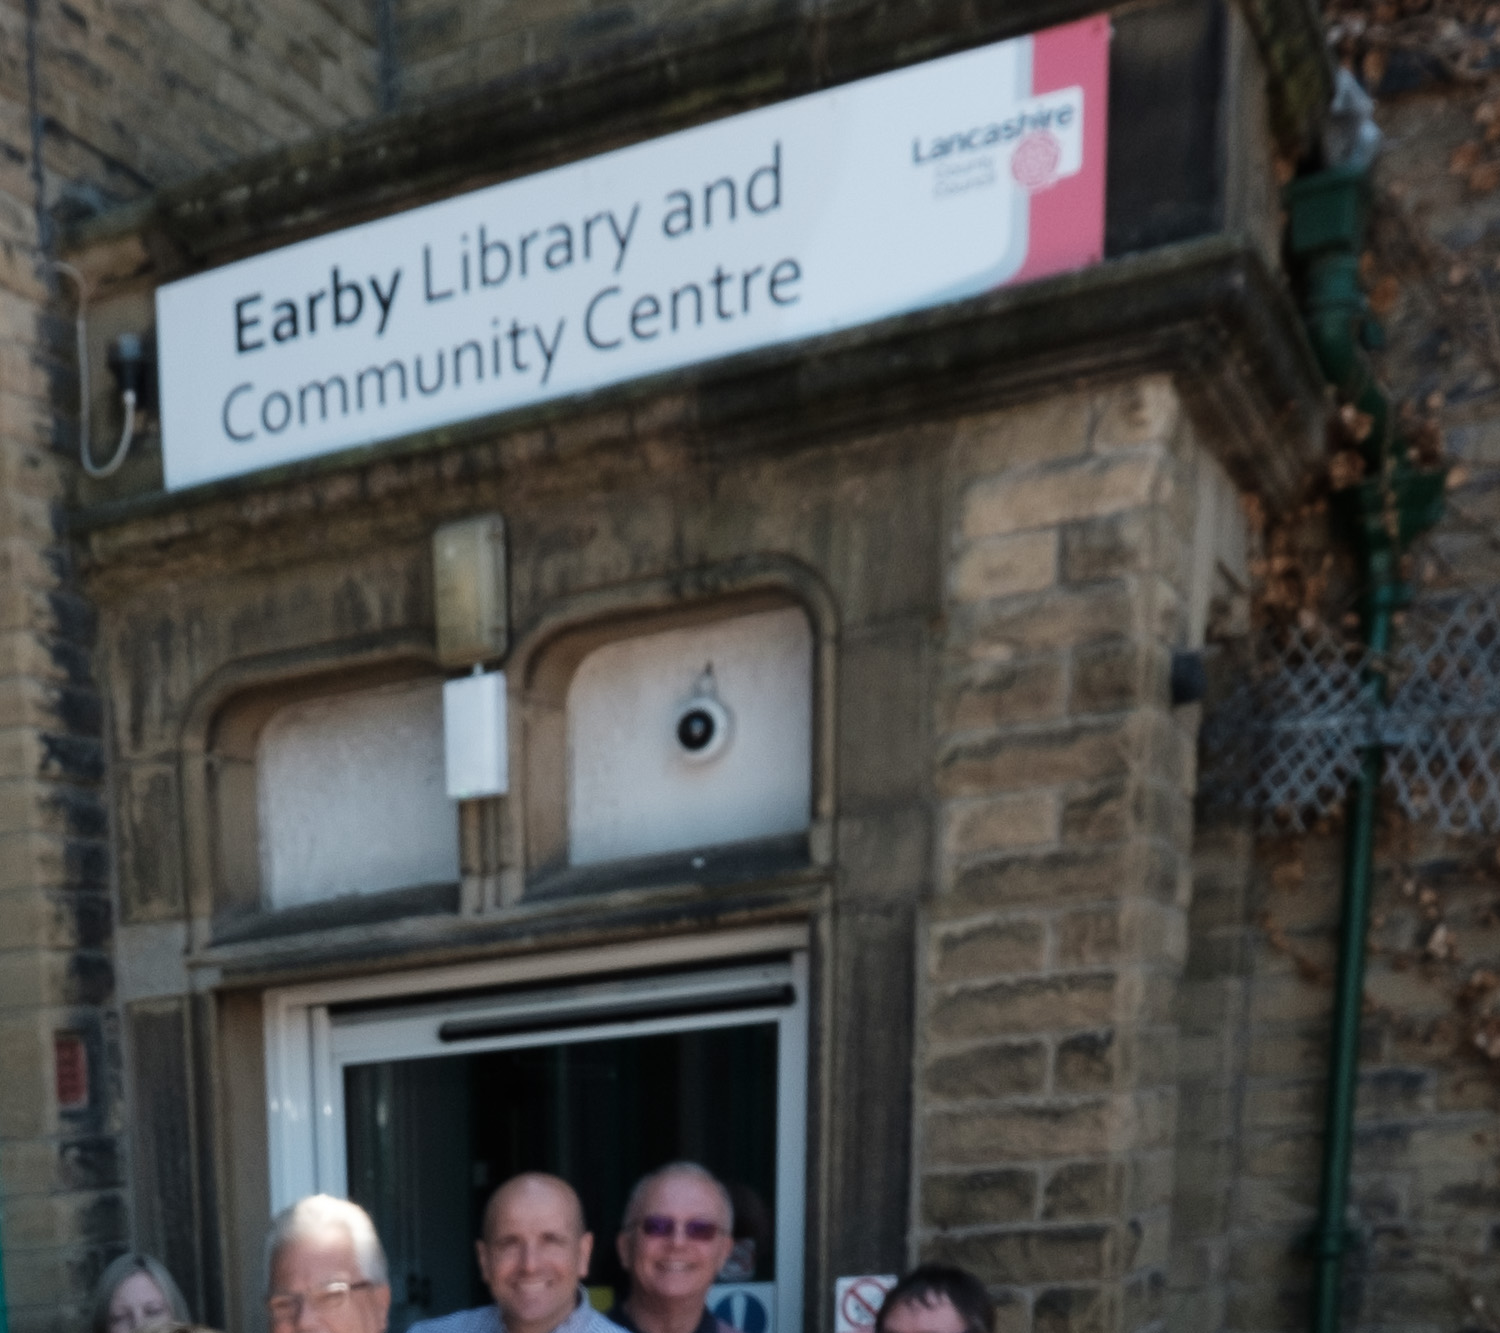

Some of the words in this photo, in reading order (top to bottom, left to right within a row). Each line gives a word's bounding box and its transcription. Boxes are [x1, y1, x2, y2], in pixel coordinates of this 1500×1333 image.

[911, 103, 1075, 167] Lancashire
[231, 264, 403, 357] Earby
[421, 205, 640, 305] Library
[661, 142, 783, 240] and
[220, 320, 565, 444] Community
[583, 258, 803, 351] Centre
